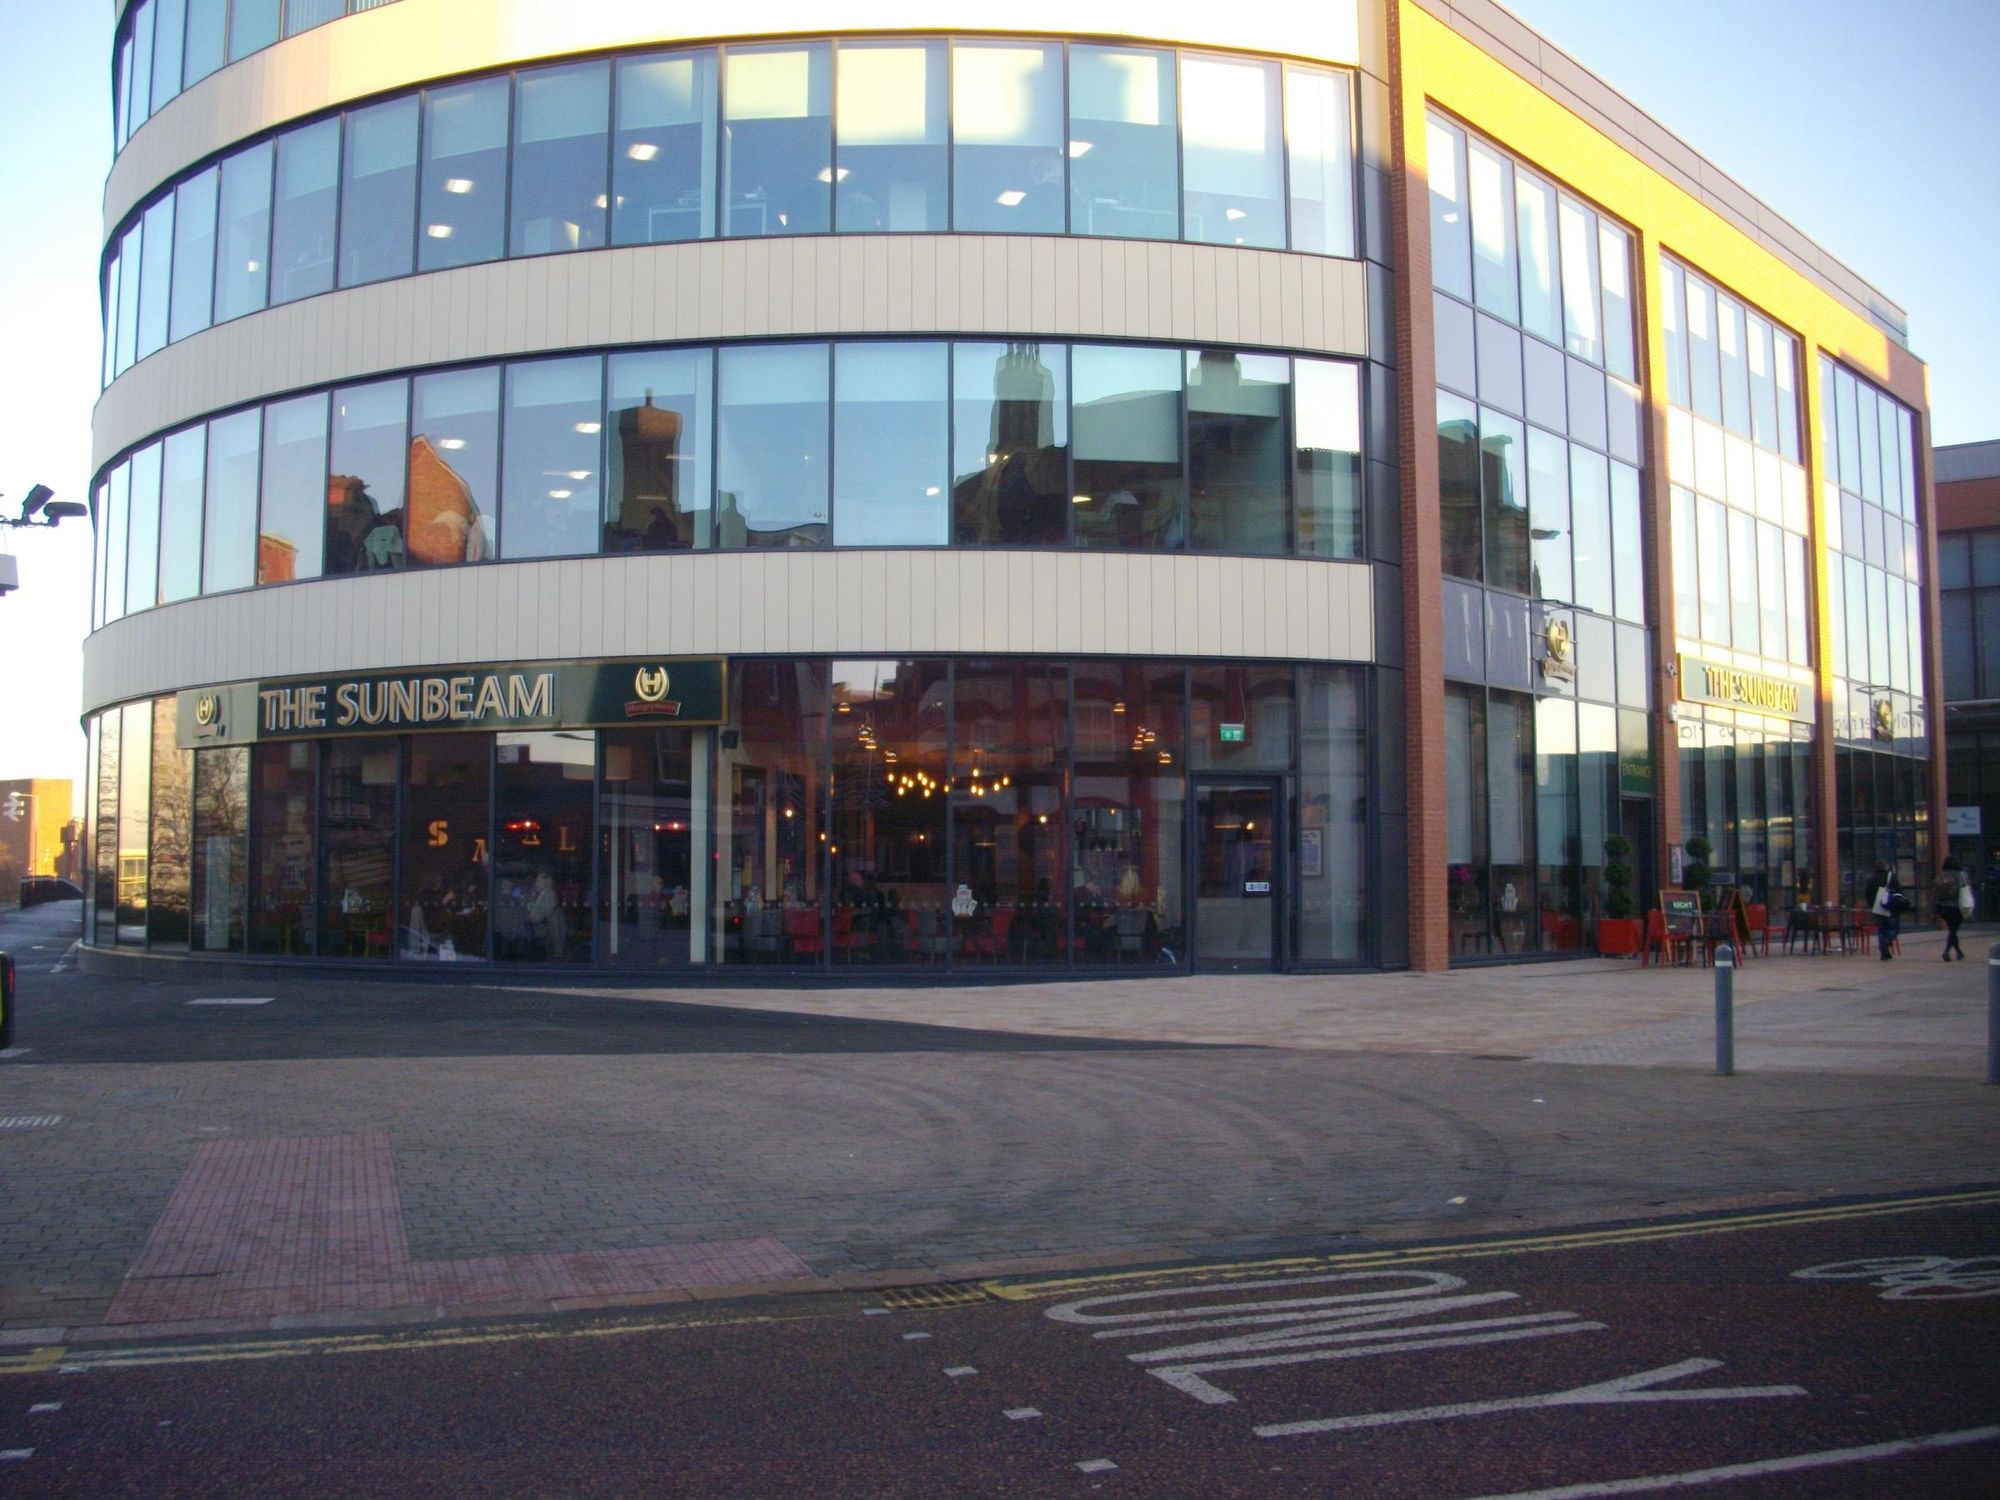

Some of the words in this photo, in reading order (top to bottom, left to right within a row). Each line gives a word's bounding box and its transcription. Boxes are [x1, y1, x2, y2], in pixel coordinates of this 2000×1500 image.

[258, 685, 327, 730] THE
[336, 674, 553, 726] SUNBEAM
[1703, 666, 1737, 700] THE
[1737, 673, 1799, 713] SUNBEAM
[1043, 1268, 1809, 1440] ONLY
